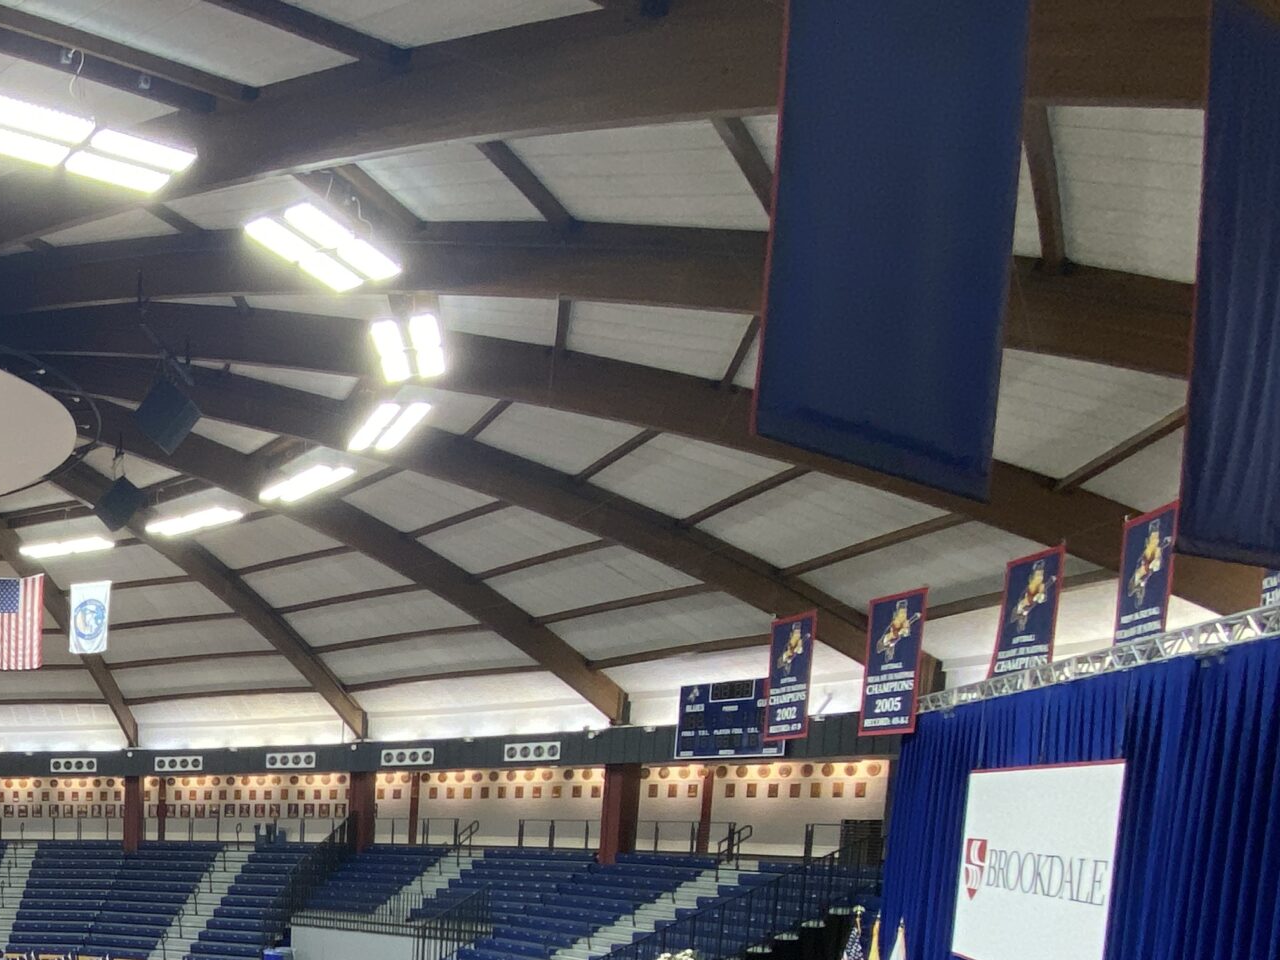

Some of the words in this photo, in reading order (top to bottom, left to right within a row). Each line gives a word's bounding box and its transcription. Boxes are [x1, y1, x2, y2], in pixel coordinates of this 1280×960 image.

[994, 655, 1048, 673] CHAMPIONS
[866, 679, 915, 695] CHAMPIONS
[769, 691, 807, 705] CHAMPIONS
[874, 697, 902, 713] 2005
[776, 707, 797, 721] 2002
[985, 849, 1109, 906] BROOKDALE
